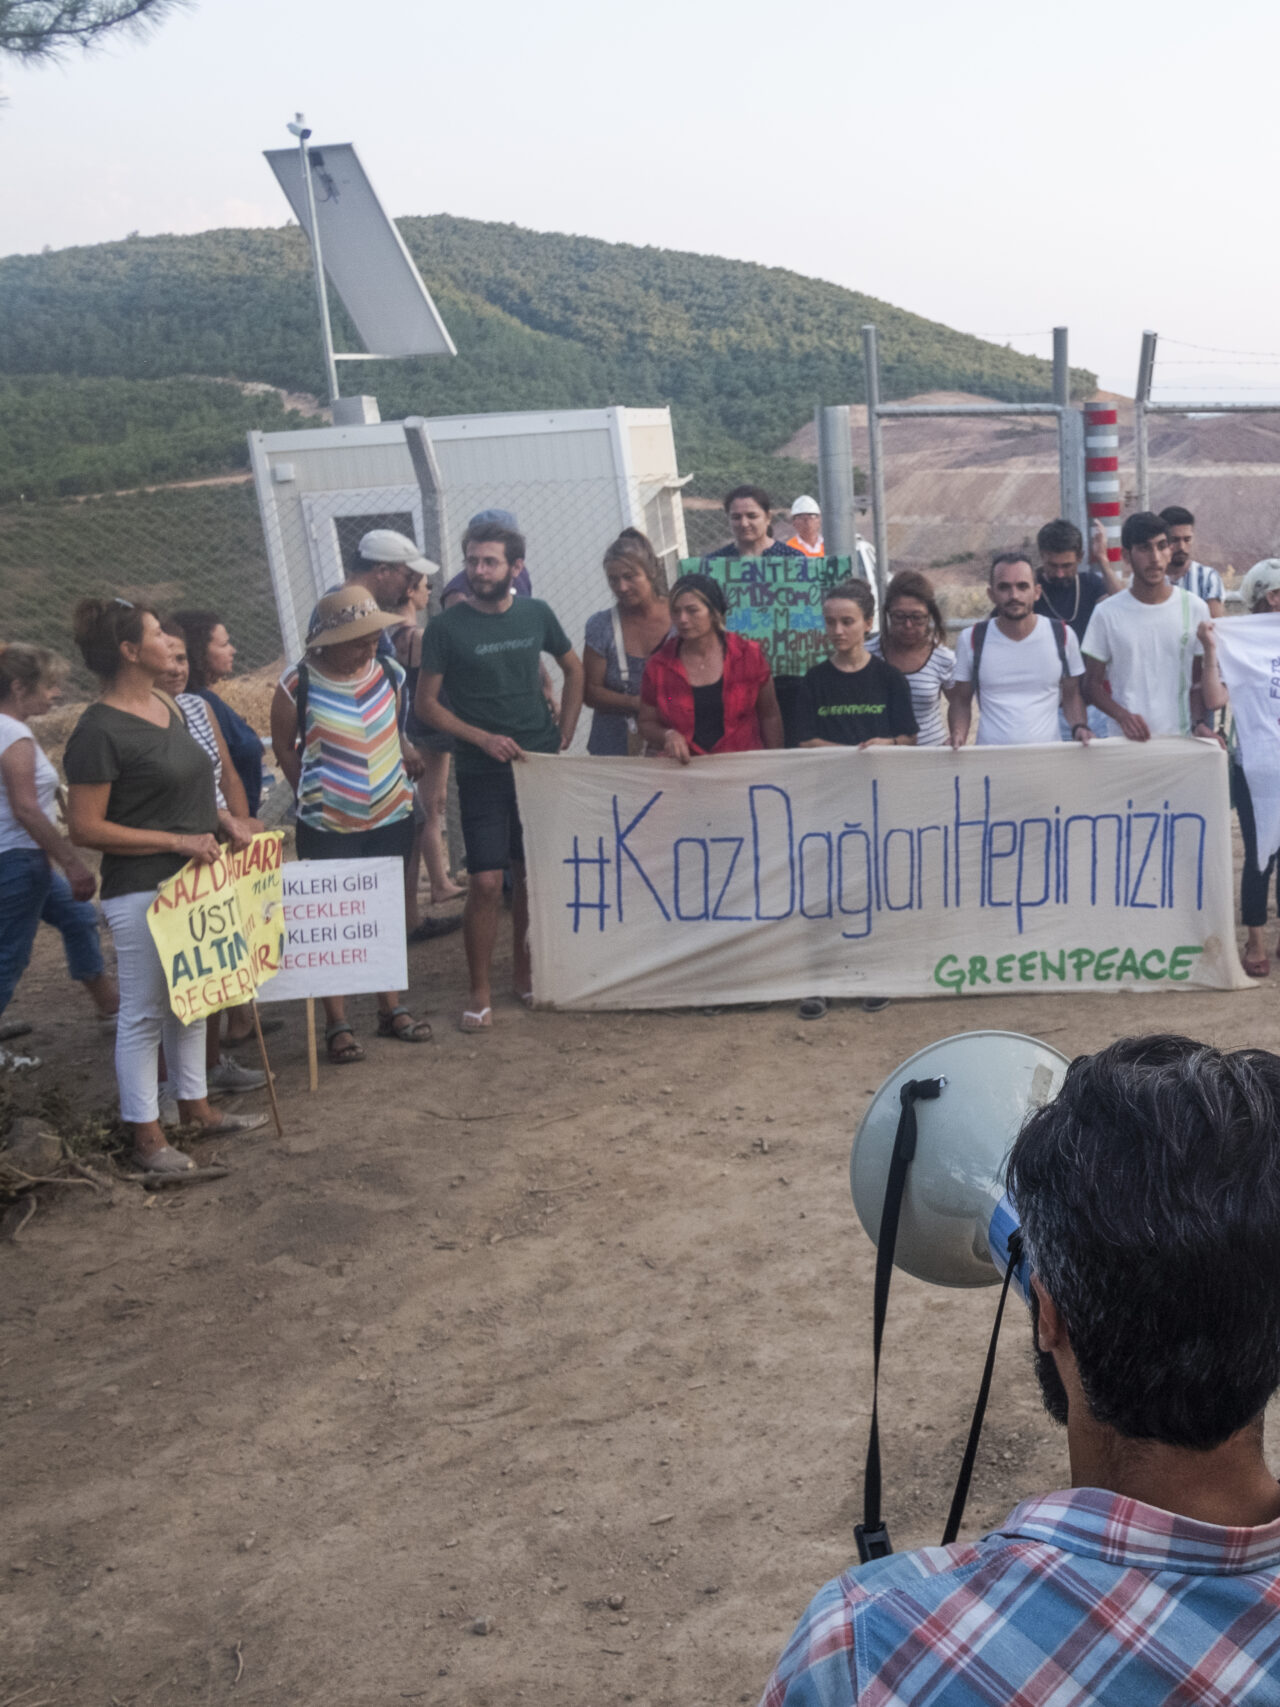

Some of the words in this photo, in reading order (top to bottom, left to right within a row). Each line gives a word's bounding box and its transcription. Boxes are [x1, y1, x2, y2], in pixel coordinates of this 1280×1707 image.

[563, 776, 1206, 938] #KazDağlarıHepimizin
[282, 873, 337, 896] İKLERİ
[343, 872, 378, 892] GİBİ
[282, 899, 366, 922] ECEKLER!
[287, 922, 337, 945] KLERİ
[343, 920, 378, 940] GİBİ
[282, 947, 367, 970] ECEKLER!
[934, 945, 1204, 994] GREENPEACE
